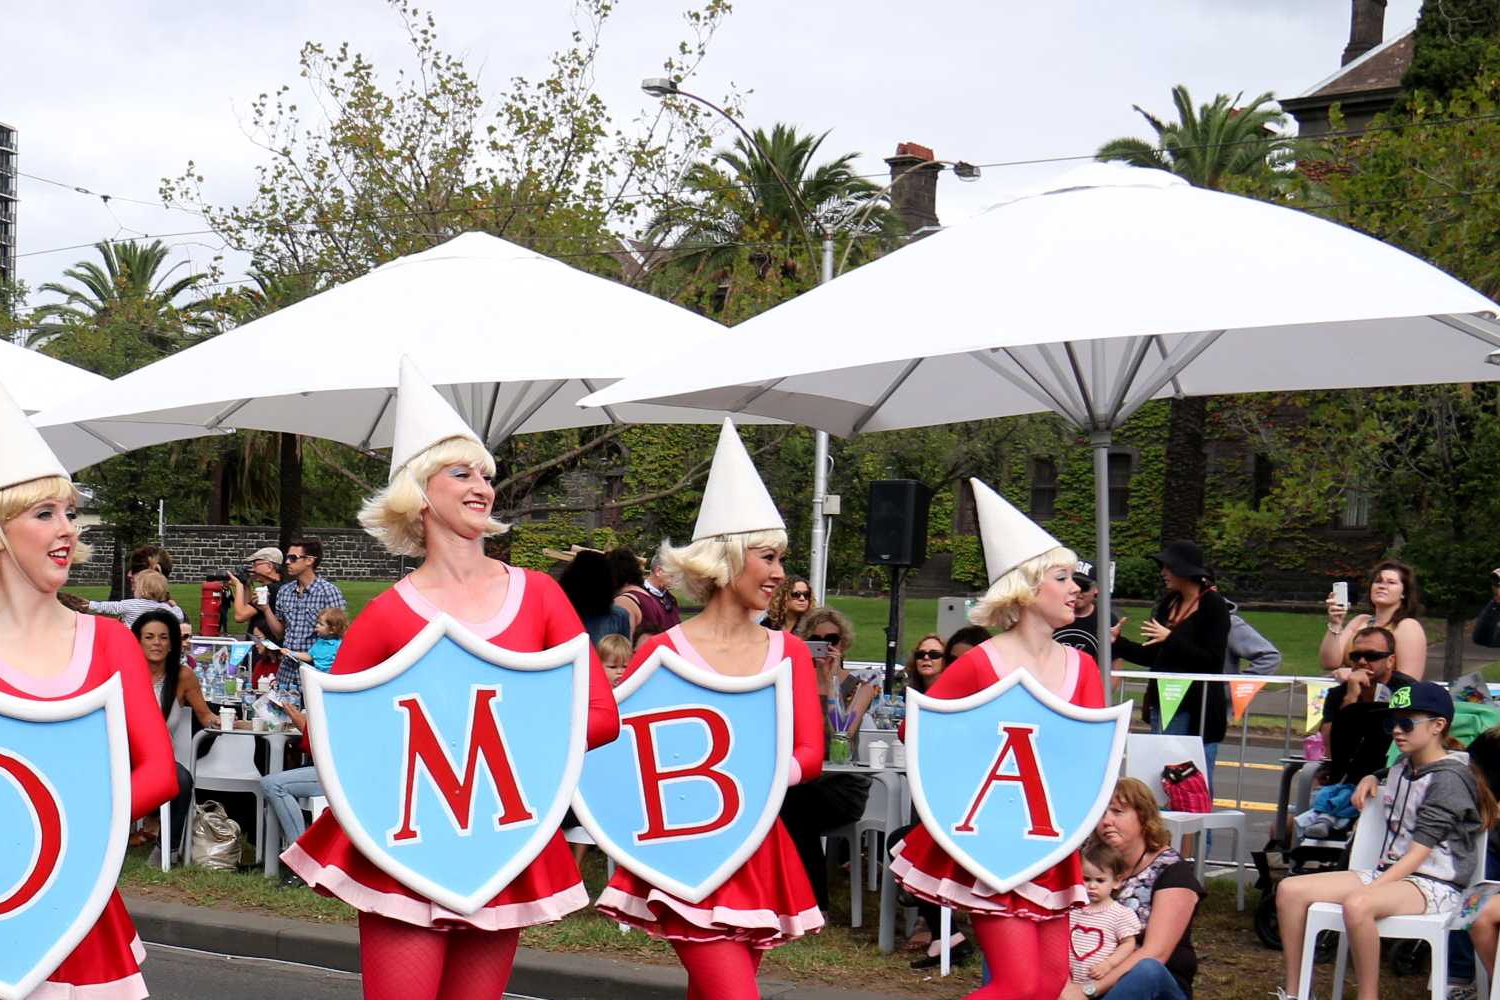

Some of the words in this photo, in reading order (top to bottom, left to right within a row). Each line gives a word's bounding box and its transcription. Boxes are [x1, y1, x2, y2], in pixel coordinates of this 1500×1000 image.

[392, 688, 534, 842] M
[621, 708, 740, 841] B
[955, 726, 1059, 838] A
